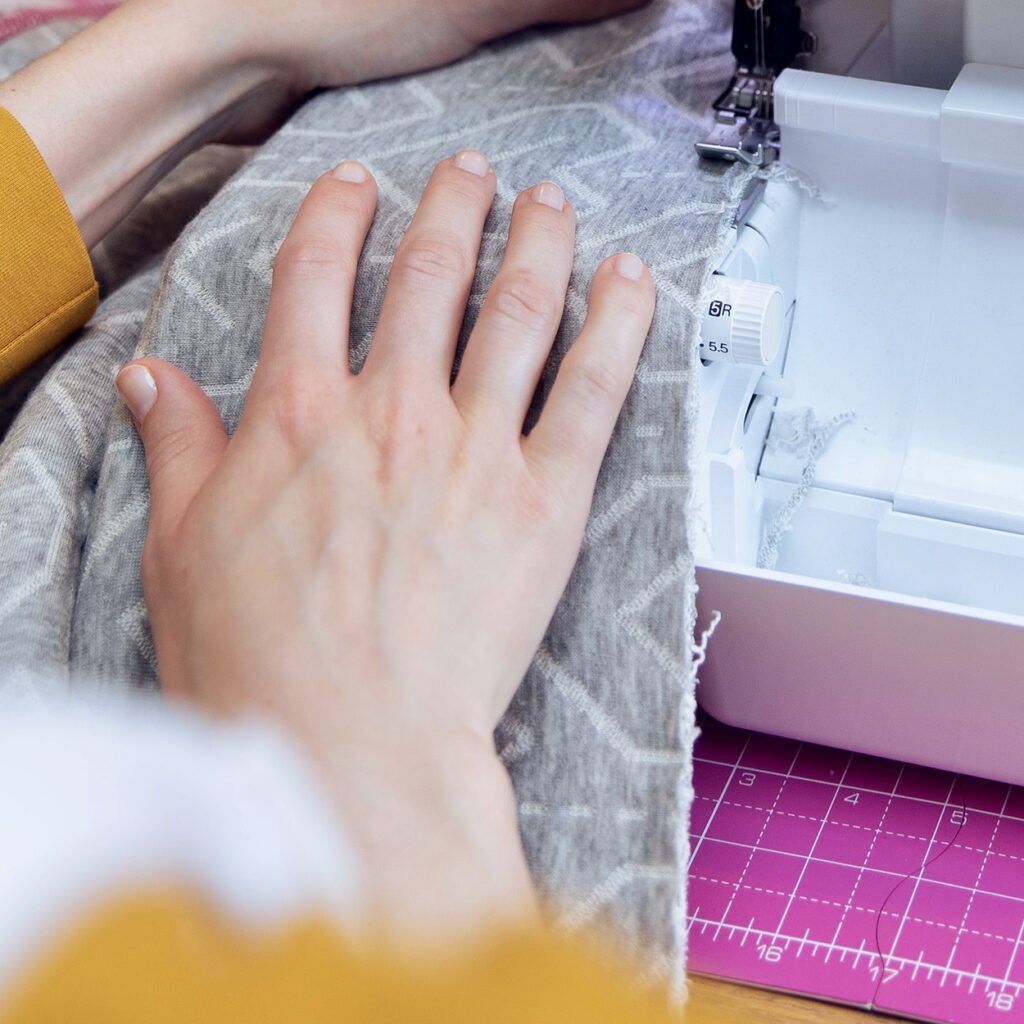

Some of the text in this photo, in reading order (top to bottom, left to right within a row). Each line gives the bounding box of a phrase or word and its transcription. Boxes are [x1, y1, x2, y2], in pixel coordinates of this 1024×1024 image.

[708, 341, 729, 354] 5.5
[739, 772, 756, 787] 3
[844, 792, 860, 806] 4
[950, 810, 968, 826] 5
[756, 943, 1015, 1012] 16 17 18
